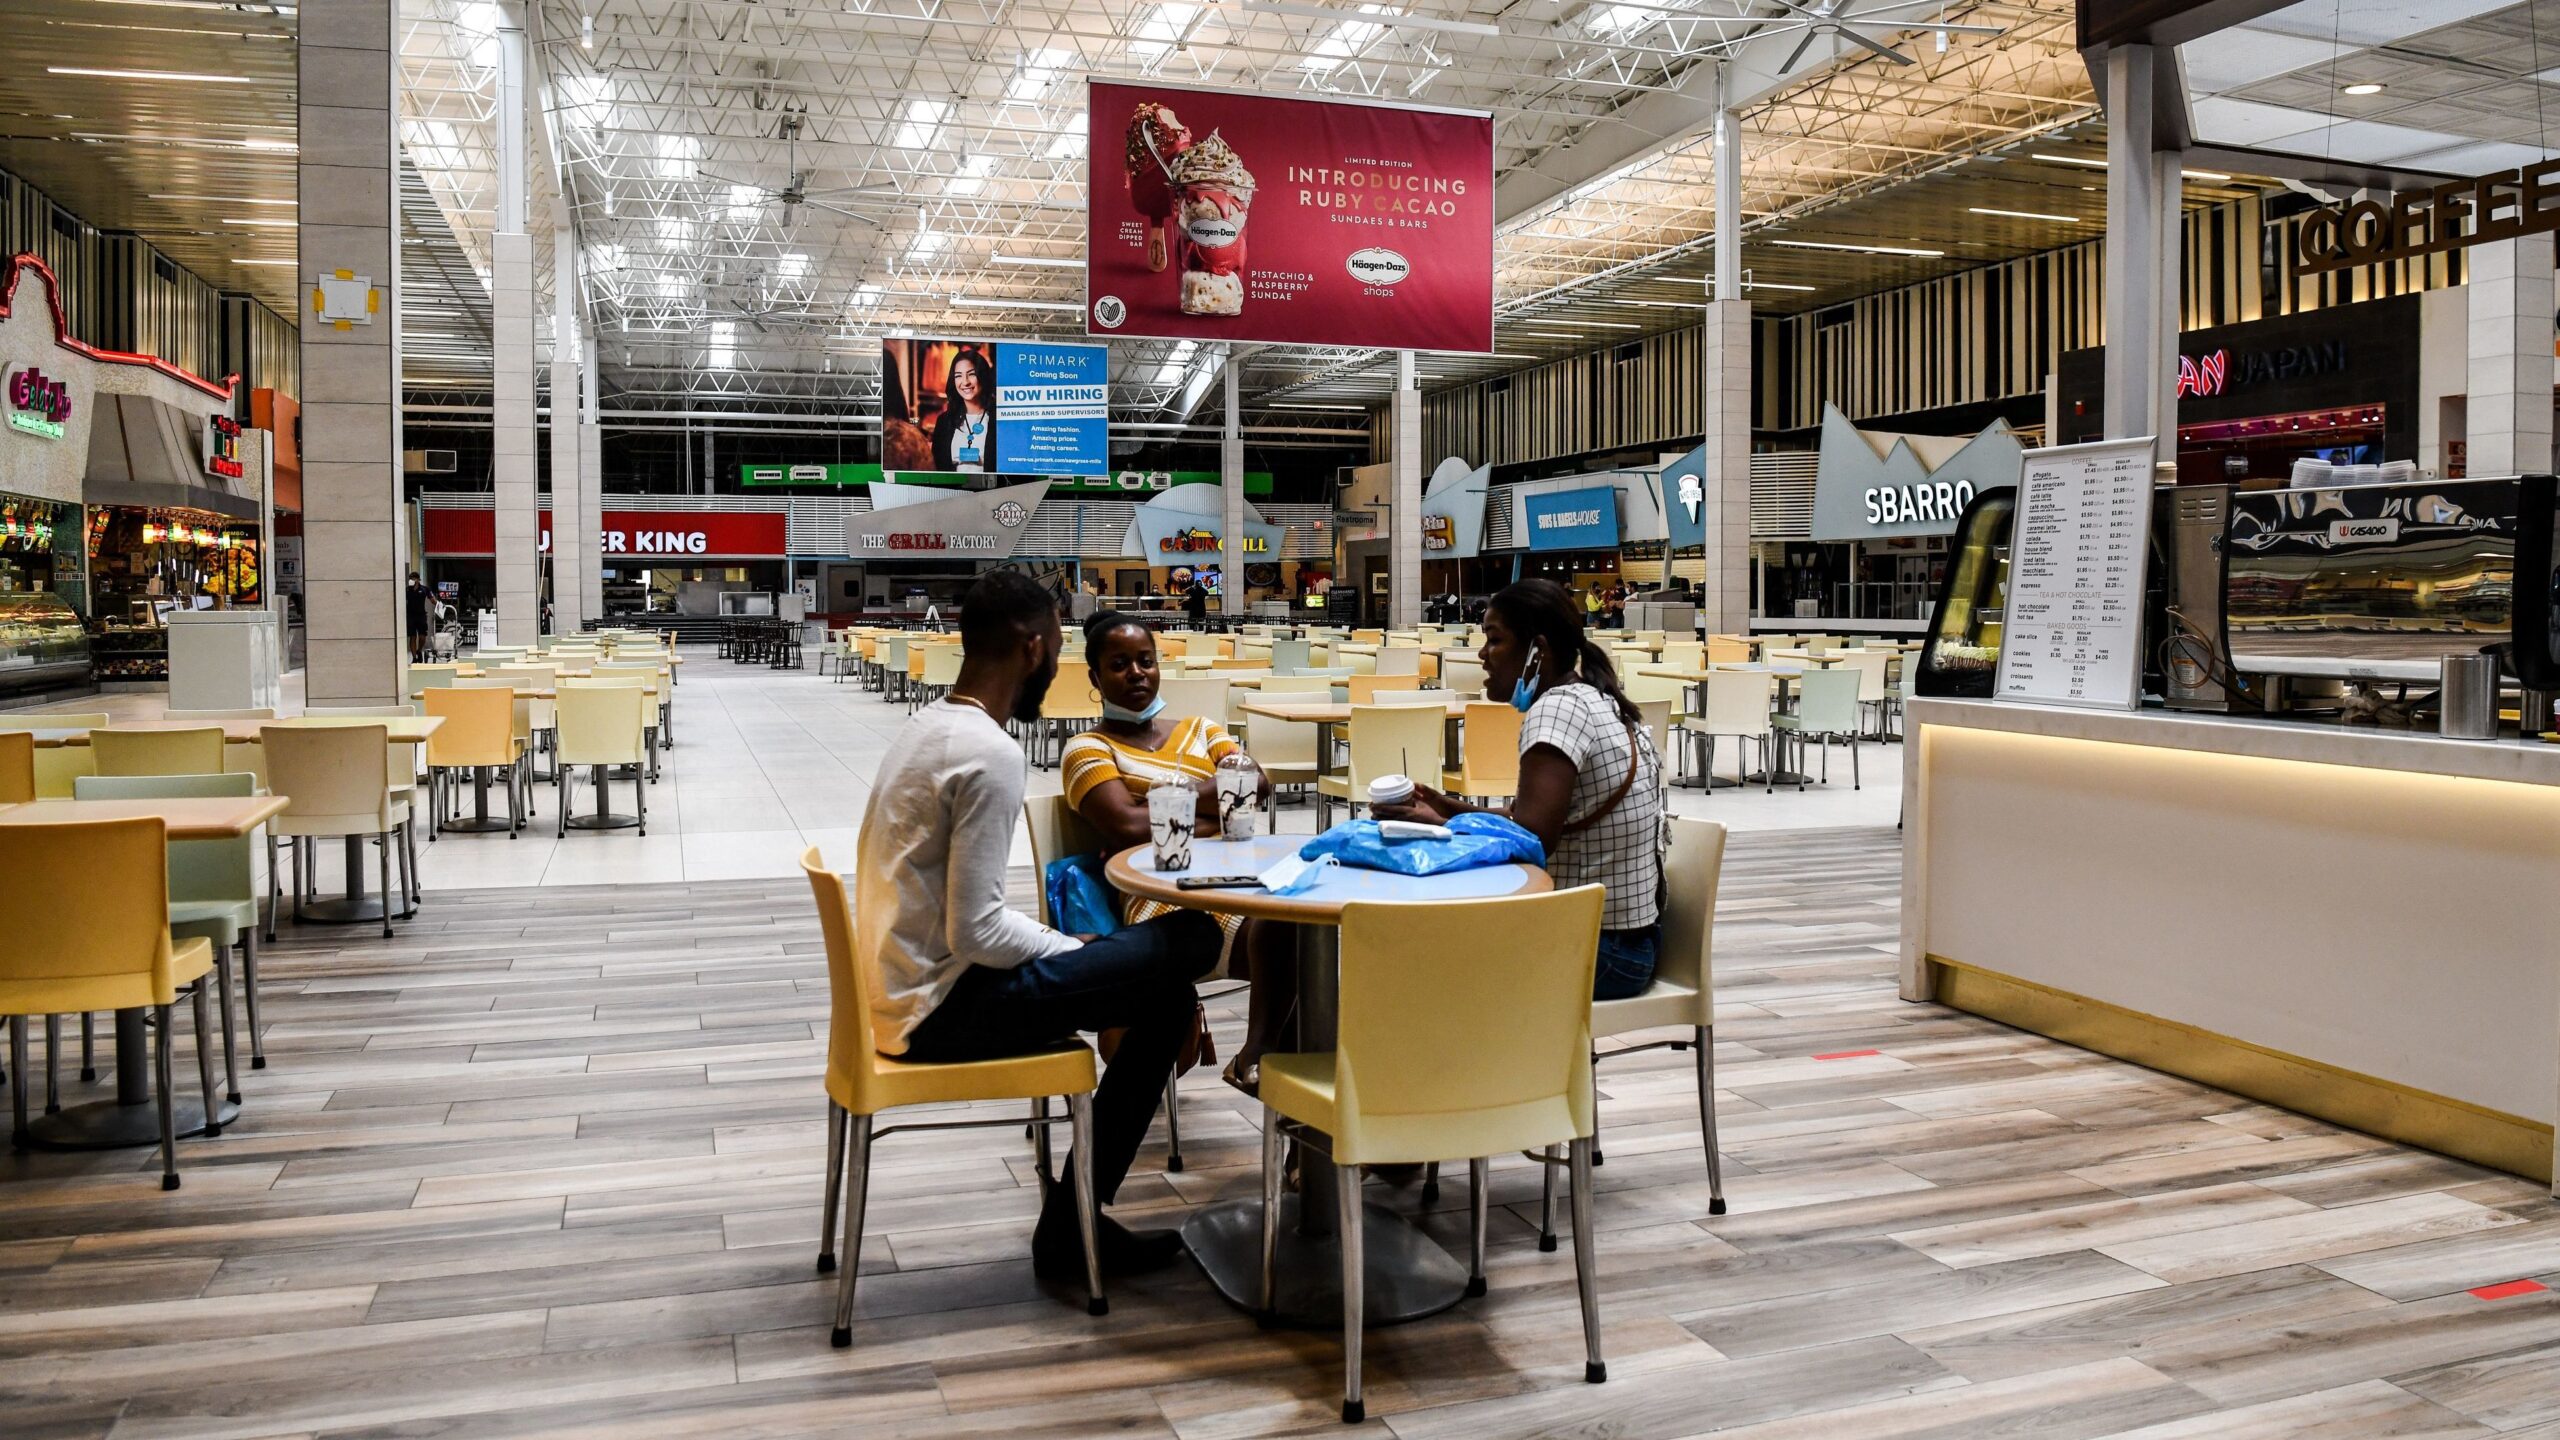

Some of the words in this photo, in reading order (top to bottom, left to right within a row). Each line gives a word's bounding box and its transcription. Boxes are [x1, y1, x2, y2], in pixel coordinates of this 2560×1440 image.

[1345, 157, 1376, 166] LIMITED
[1380, 160, 1413, 168] EDITION
[1289, 166, 1466, 195] INTRODUCING
[1300, 190, 1363, 210] RUBY
[1374, 196, 1456, 216] CACAO
[2300, 160, 2560, 265] COFFEE
[1331, 214, 1383, 226] SUNDAES
[1388, 218, 1394, 226] &
[1400, 220, 1428, 229] BARS
[1191, 227, 1236, 237] Häagen-Dazs
[1352, 260, 1406, 272] Häagen-Dazs
[1251, 271, 1305, 280] PISTACHIO
[1251, 281, 1308, 291] RASPBERRY
[1364, 286, 1394, 298] shops
[1251, 291, 1292, 300] SUNDAE
[1018, 354, 1087, 367] PRIMARK
[1029, 370, 1057, 379] Coming
[2178, 350, 2224, 399] AN
[2234, 341, 2345, 385] JAPAN
[1004, 390, 1041, 401] NOW
[1046, 389, 1103, 400] HIRING
[1865, 480, 1974, 524] SBARRO
[2351, 526, 2387, 536] CASADIO
[636, 531, 707, 553] KING
[861, 534, 884, 548] THE
[888, 533, 946, 549] GRILL
[950, 535, 997, 549] FACTORY
[1160, 536, 1216, 552] CAJUN
